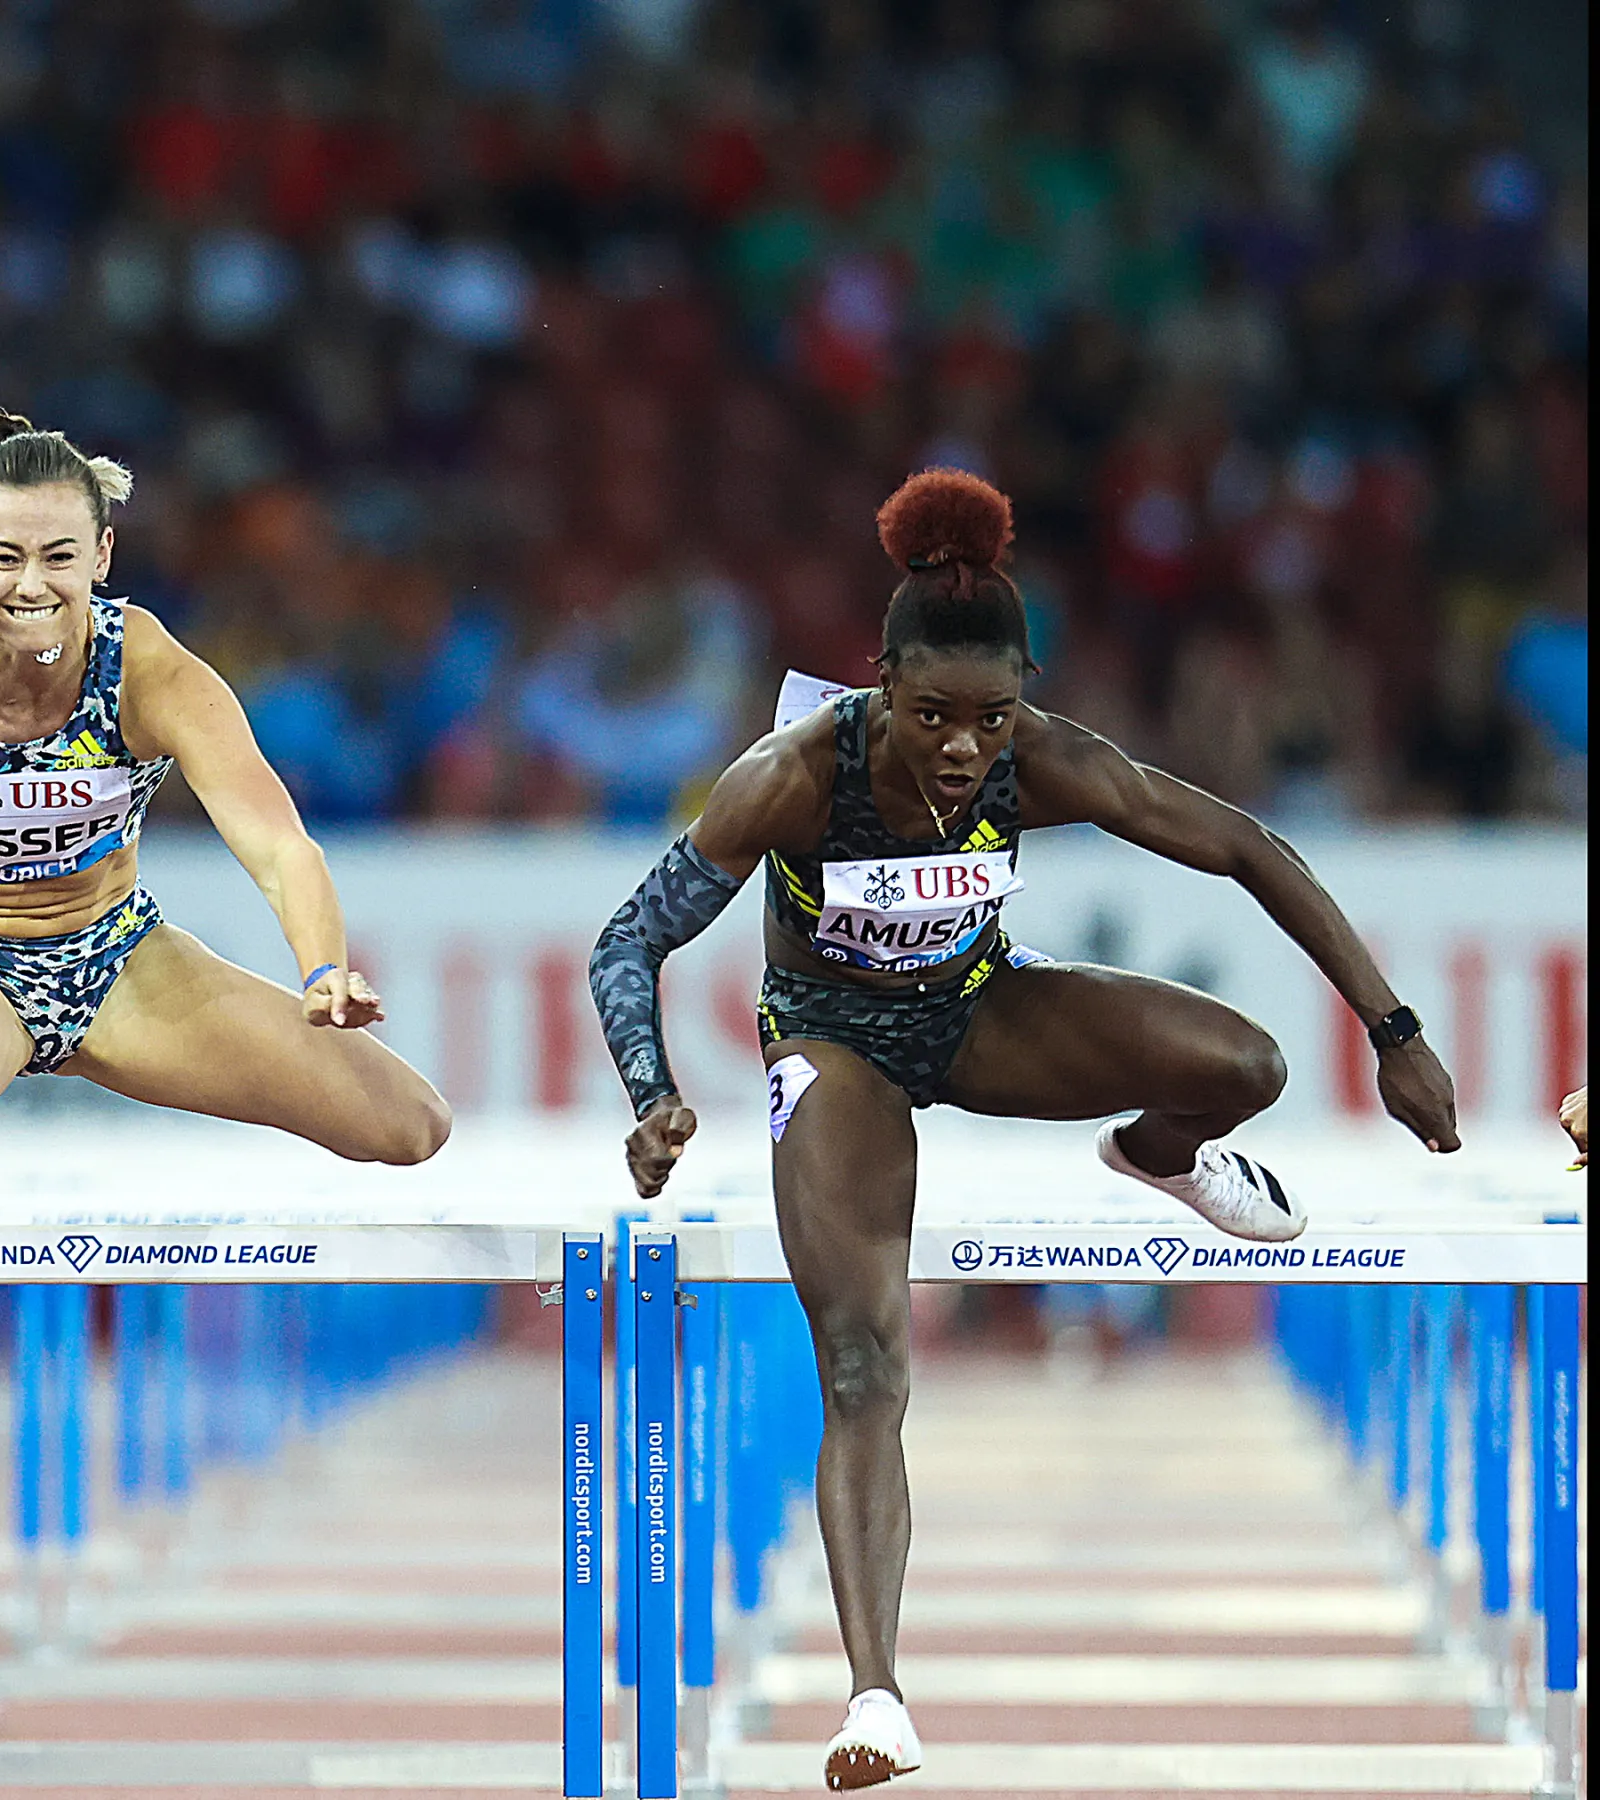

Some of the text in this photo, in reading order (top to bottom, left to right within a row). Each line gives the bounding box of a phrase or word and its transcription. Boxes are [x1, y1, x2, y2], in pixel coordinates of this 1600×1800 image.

[54, 753, 116, 770] adidas
[9, 780, 93, 809] UBS
[911, 863, 990, 900] UBS
[826, 895, 1004, 949] AMUSAN
[105, 1245, 217, 1264] DIAMOND
[224, 1245, 317, 1264] LEAGUE
[1192, 1248, 1305, 1267] DIAMOND
[1311, 1248, 1406, 1267] LEAGUE
[571, 1423, 595, 1584] nordicsport.com
[645, 1421, 669, 1583] nordicsport.com
